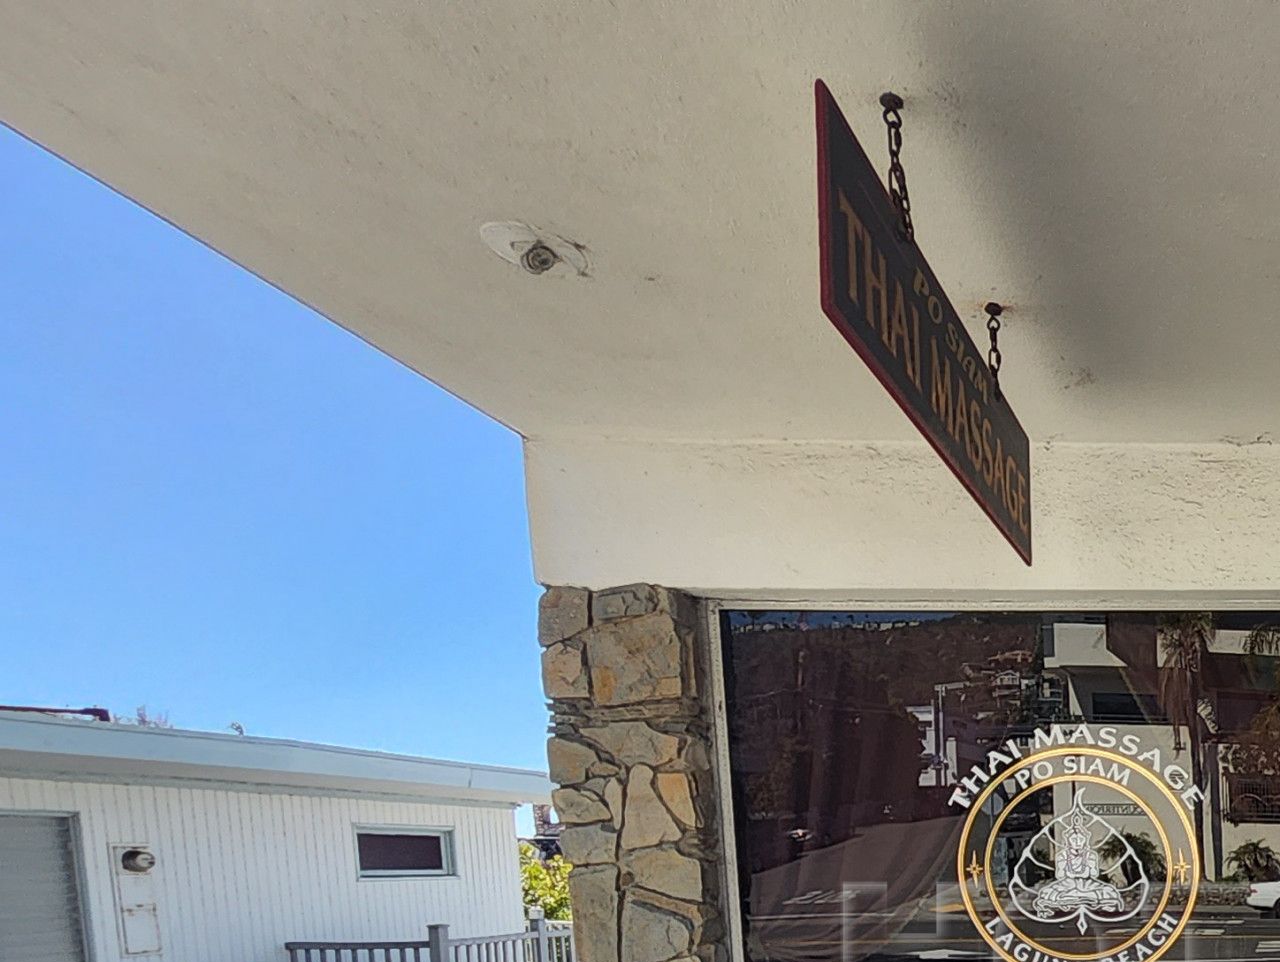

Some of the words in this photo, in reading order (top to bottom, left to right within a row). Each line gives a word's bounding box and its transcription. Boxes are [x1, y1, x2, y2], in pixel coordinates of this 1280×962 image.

[913, 267, 943, 324] PO
[838, 187, 922, 394] THAI
[931, 335, 1028, 535] MASSAGE
[948, 738, 1023, 809] THAI
[1034, 723, 1205, 811] MASSAGE
[1013, 761, 1053, 790] PO
[1064, 755, 1131, 786] SIAM
